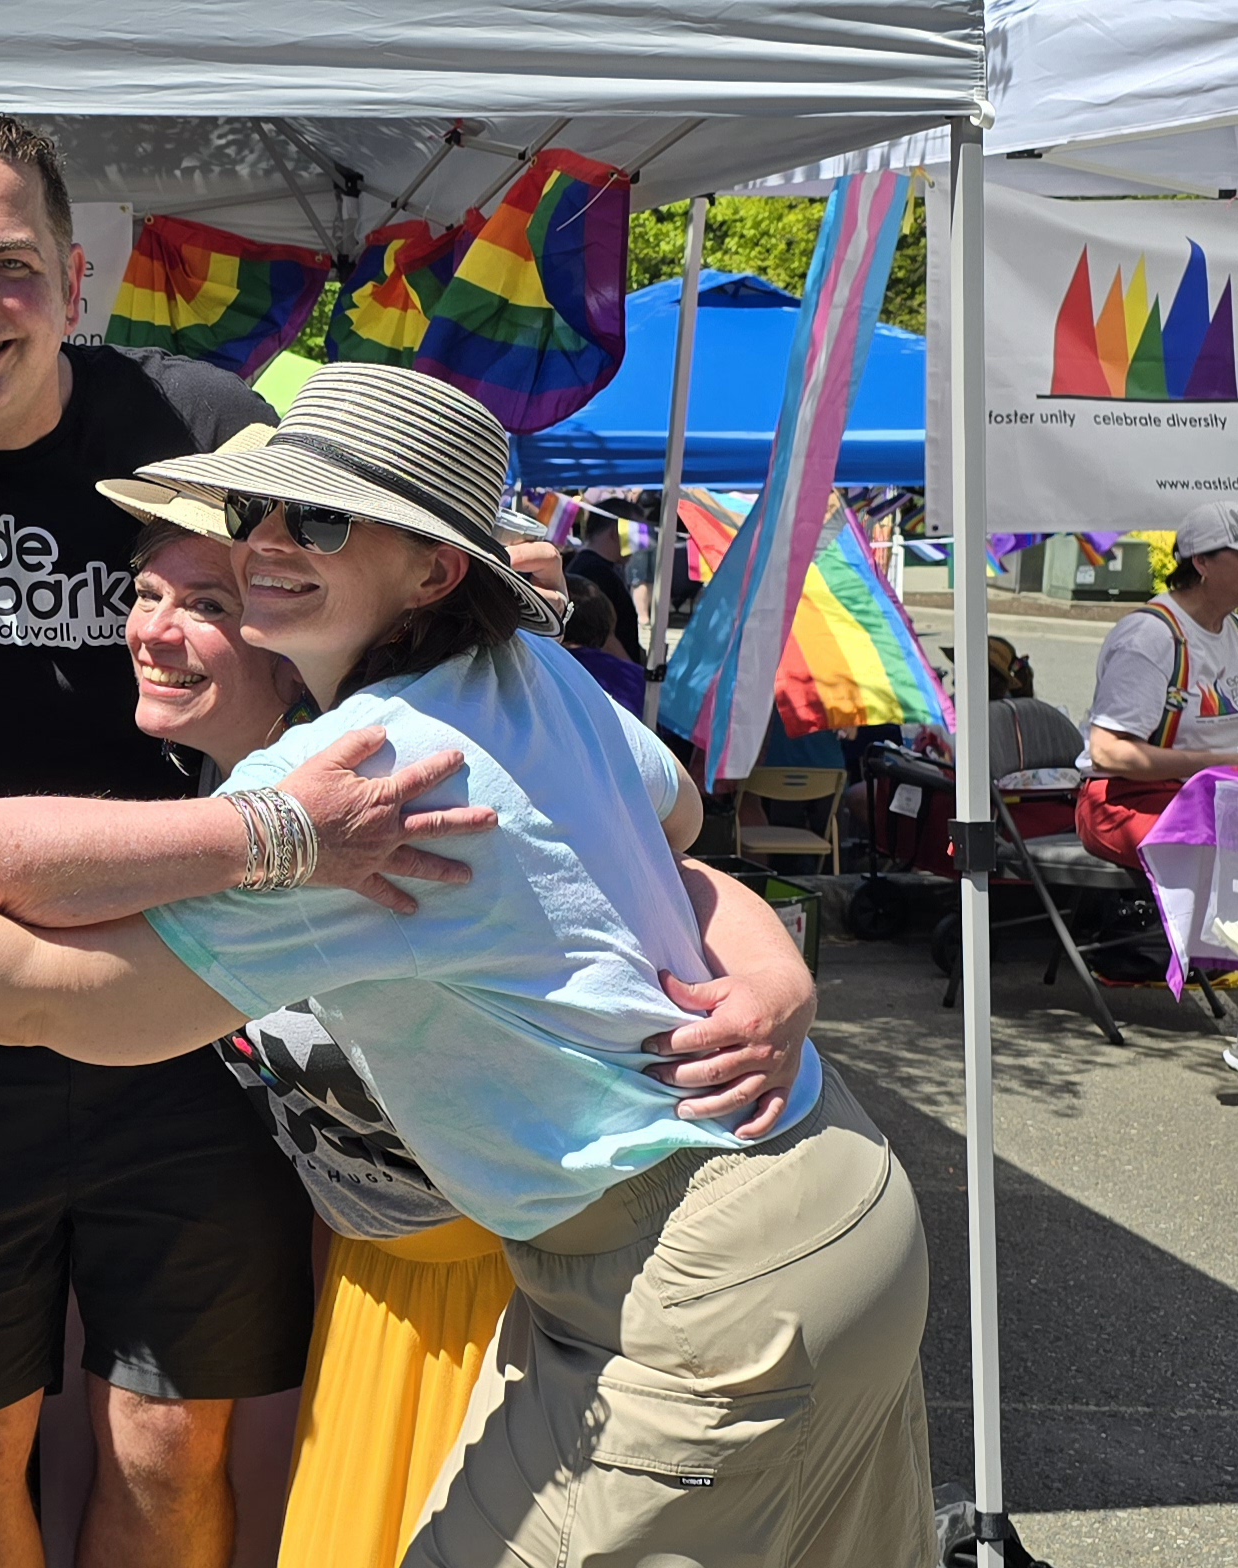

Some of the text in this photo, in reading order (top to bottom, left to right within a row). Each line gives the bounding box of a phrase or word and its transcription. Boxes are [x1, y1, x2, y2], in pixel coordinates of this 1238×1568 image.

[988, 409, 1228, 431] foster unity celebrate diversity
[327, 1169, 394, 1184] HUGS
